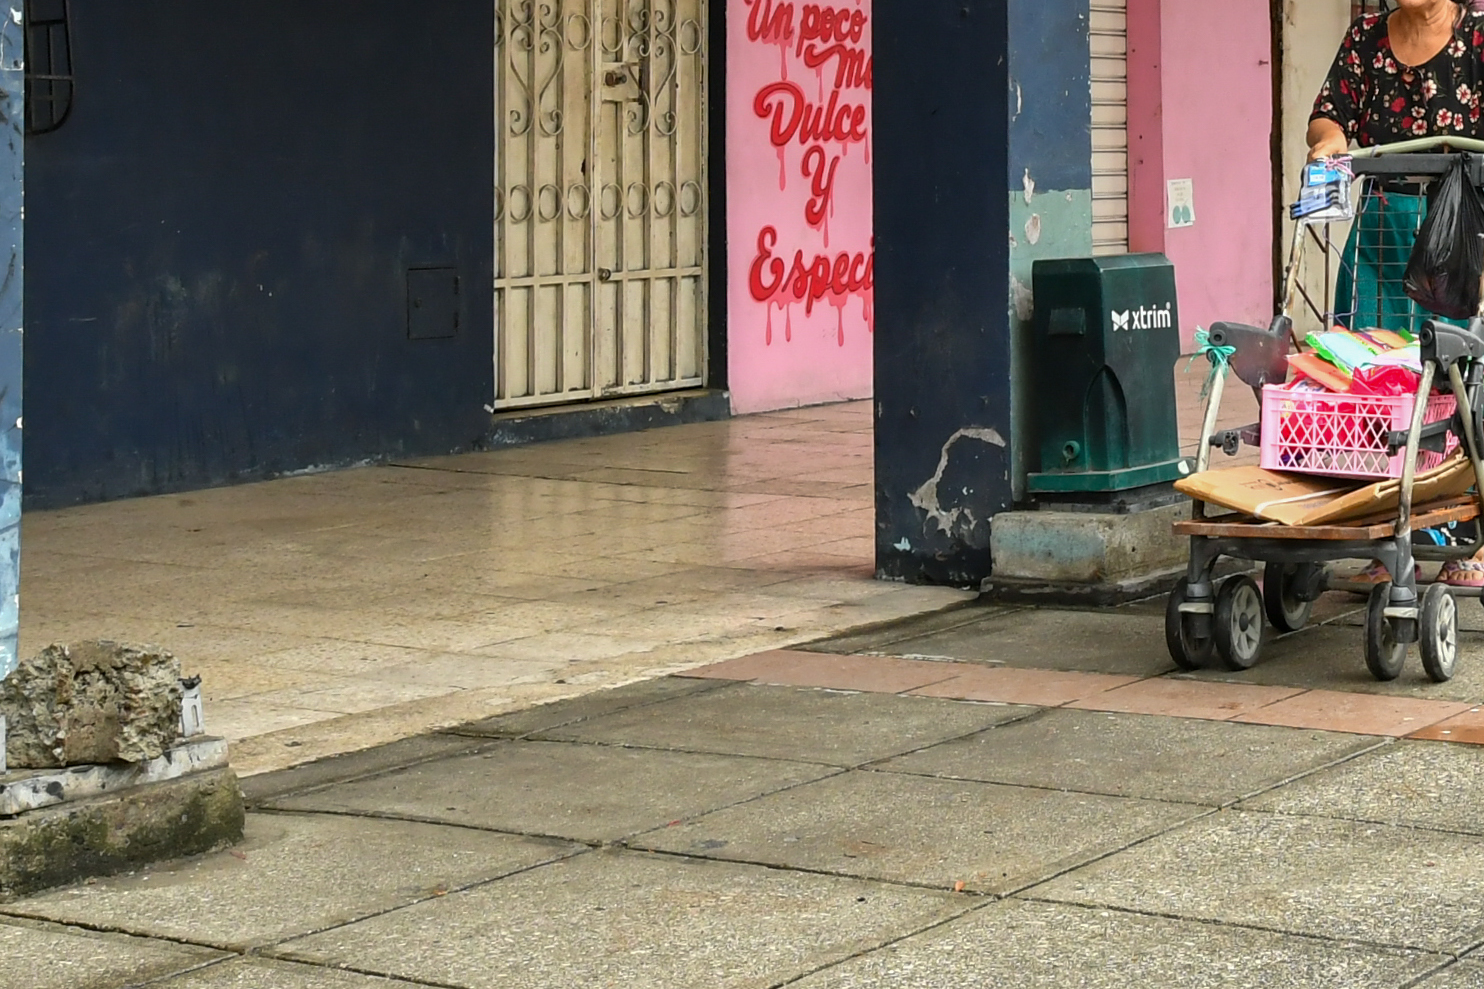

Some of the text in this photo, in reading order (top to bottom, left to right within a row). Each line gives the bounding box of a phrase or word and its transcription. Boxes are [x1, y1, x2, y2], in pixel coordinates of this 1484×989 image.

[796, 3, 867, 58] poco
[754, 81, 867, 146] Dulce
[802, 145, 840, 226] Y
[749, 225, 874, 317] Especi
[1132, 303, 1171, 330] xtrim
